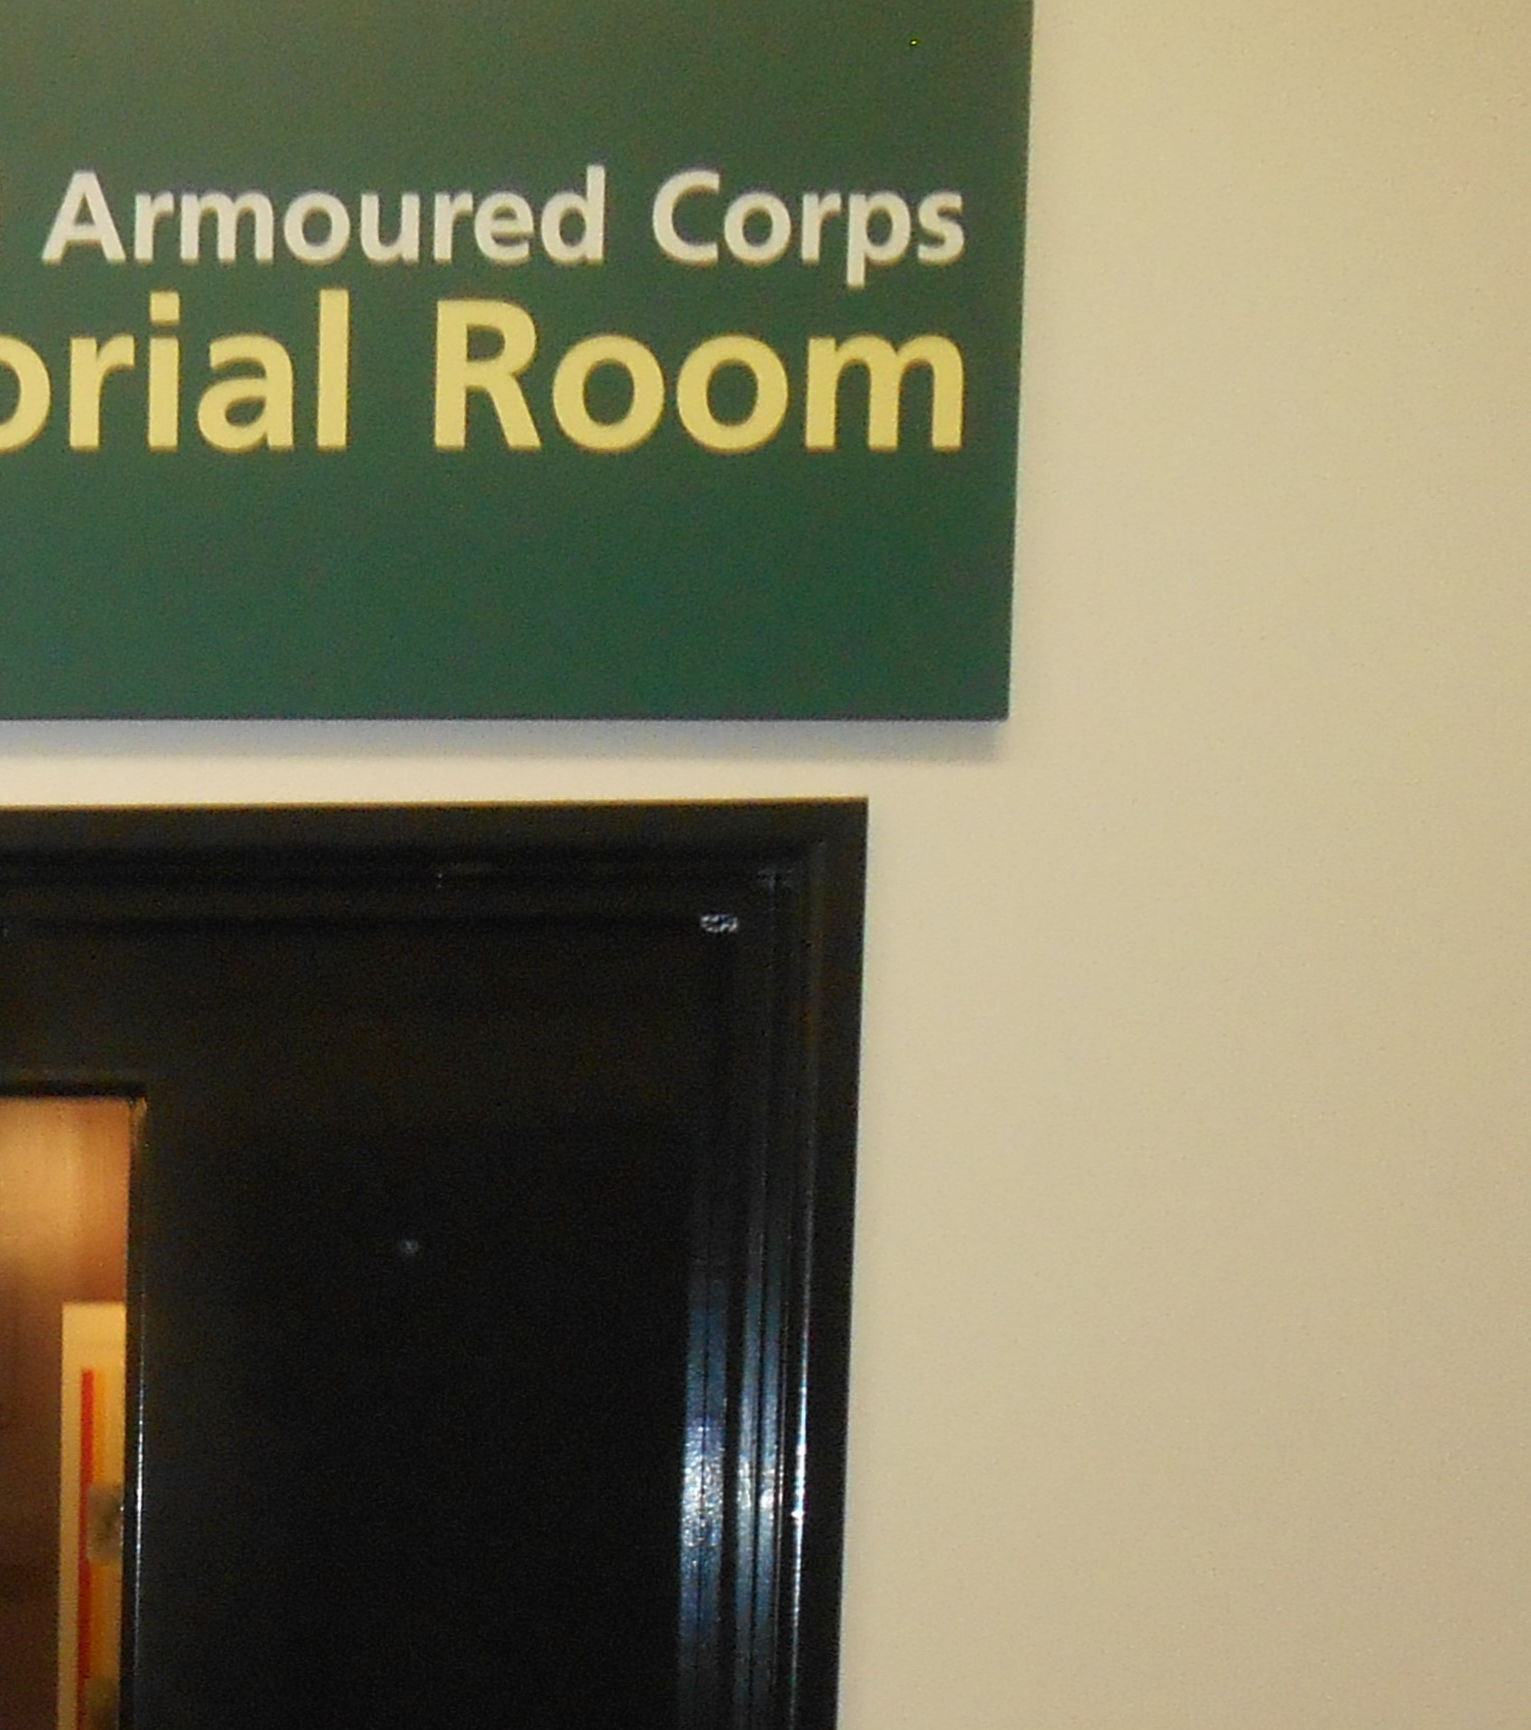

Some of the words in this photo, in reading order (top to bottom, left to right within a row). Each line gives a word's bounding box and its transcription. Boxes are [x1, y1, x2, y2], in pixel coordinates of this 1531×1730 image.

[40, 163, 607, 265] Armoured
[651, 168, 966, 288] Corps
[433, 296, 965, 453] Room
